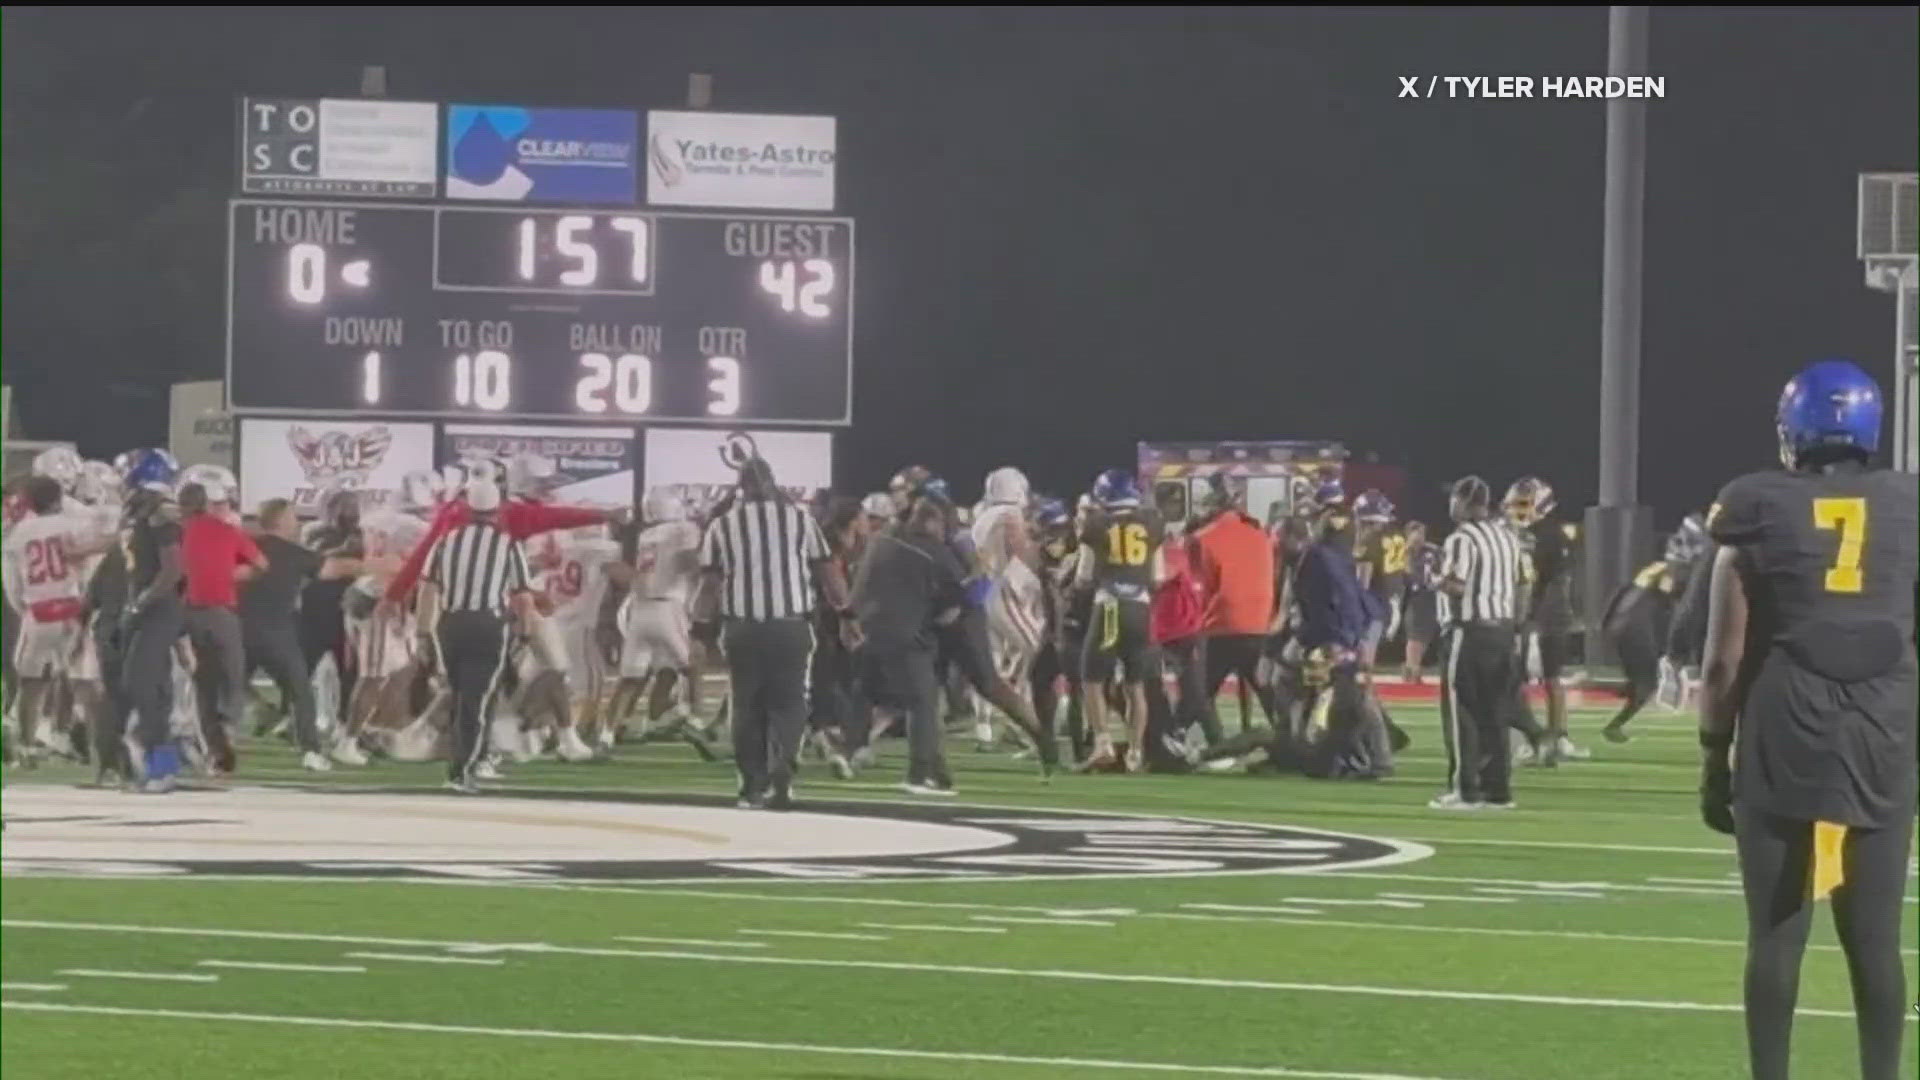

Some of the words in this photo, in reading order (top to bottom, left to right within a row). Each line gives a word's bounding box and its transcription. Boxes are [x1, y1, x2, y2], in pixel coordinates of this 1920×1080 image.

[675, 138, 834, 165] Yates-Astro
[256, 207, 356, 243] HOME
[724, 222, 835, 257] GUEST
[290, 243, 326, 303] 0
[760, 259, 835, 318] 42
[325, 317, 404, 346] DOWN
[438, 319, 471, 348] TO
[478, 320, 513, 349] GO
[570, 324, 625, 352] BALL
[630, 325, 662, 353] ON
[364, 350, 381, 405] 1
[455, 350, 511, 411] 10
[575, 353, 652, 414] 20
[707, 356, 741, 416] 3
[26, 536, 68, 585] 20
[1107, 523, 1149, 566] 16
[1812, 498, 1867, 593] 7
